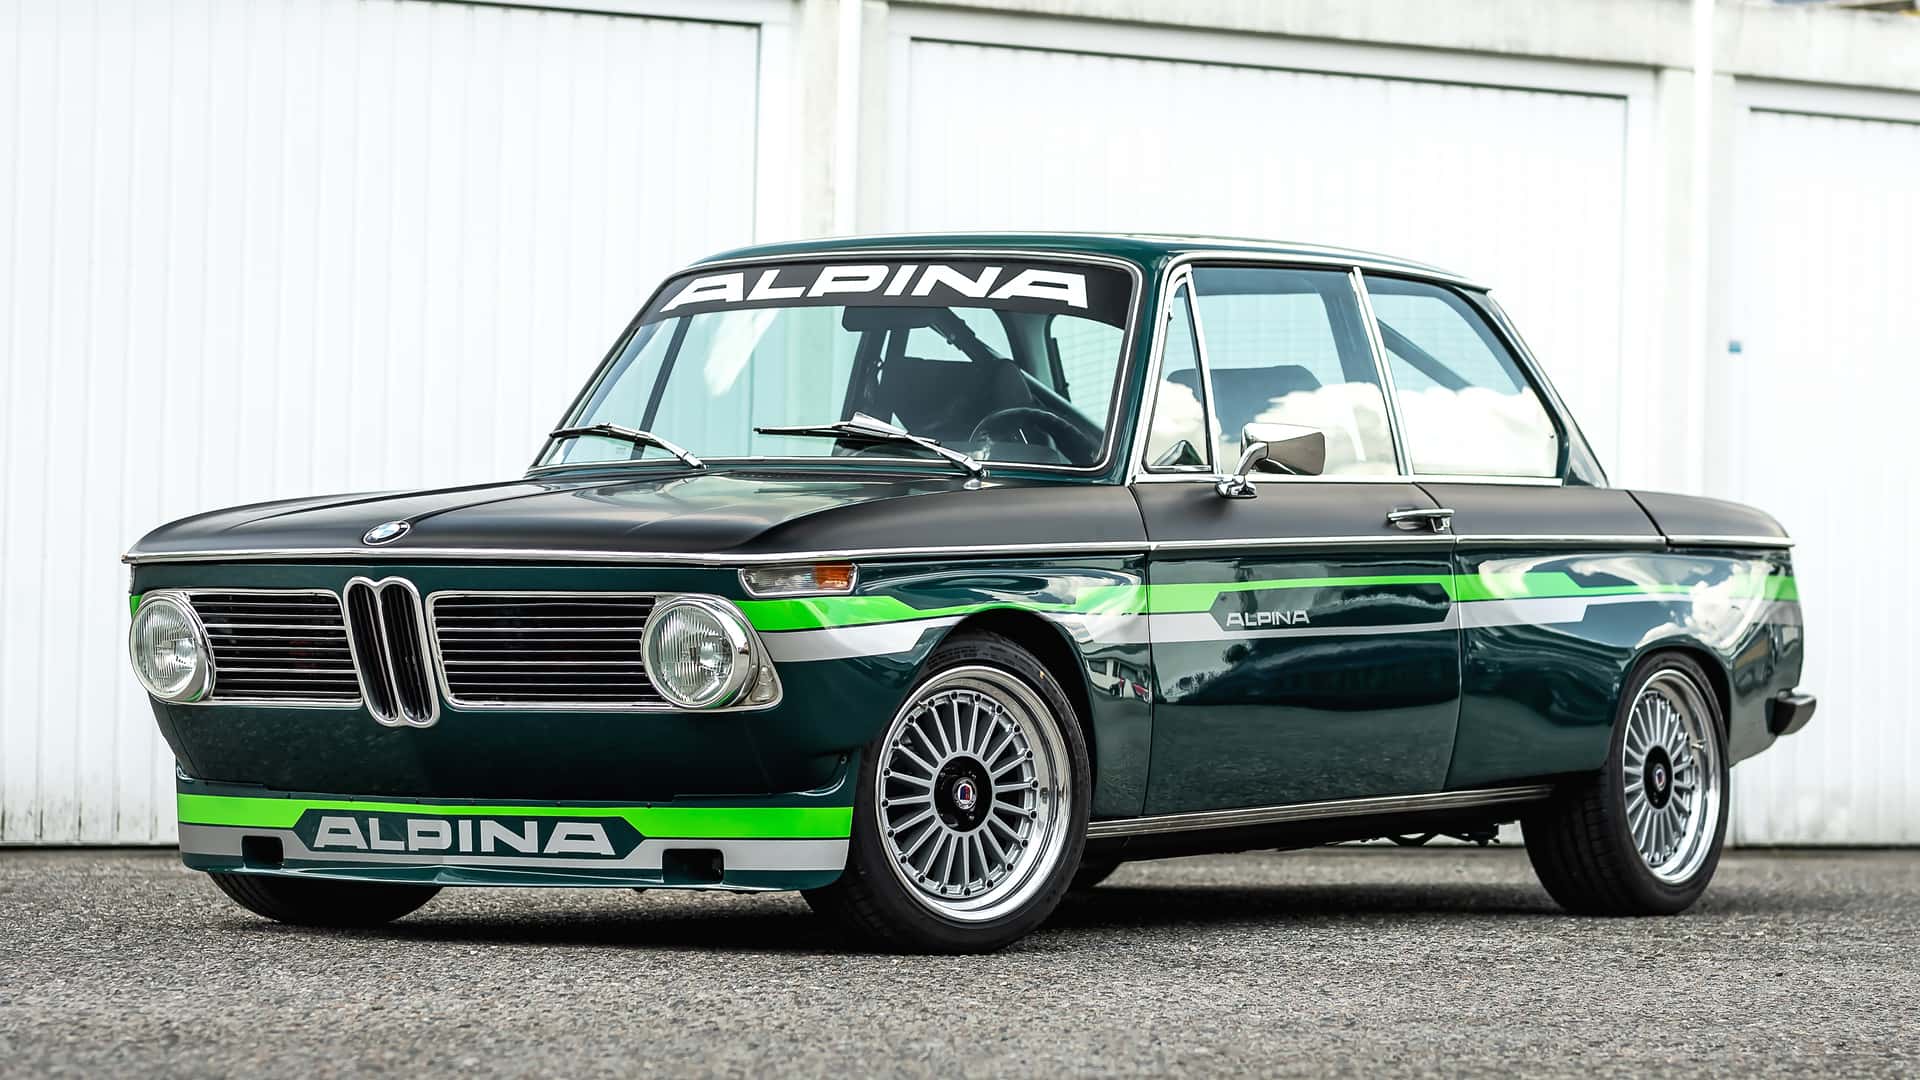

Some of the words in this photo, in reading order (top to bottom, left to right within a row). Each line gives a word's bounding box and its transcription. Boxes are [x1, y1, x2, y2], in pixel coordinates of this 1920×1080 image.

[659, 264, 1089, 312] ALPINA
[1226, 610, 1310, 627] ALPINA
[313, 815, 616, 856] ALPINA
